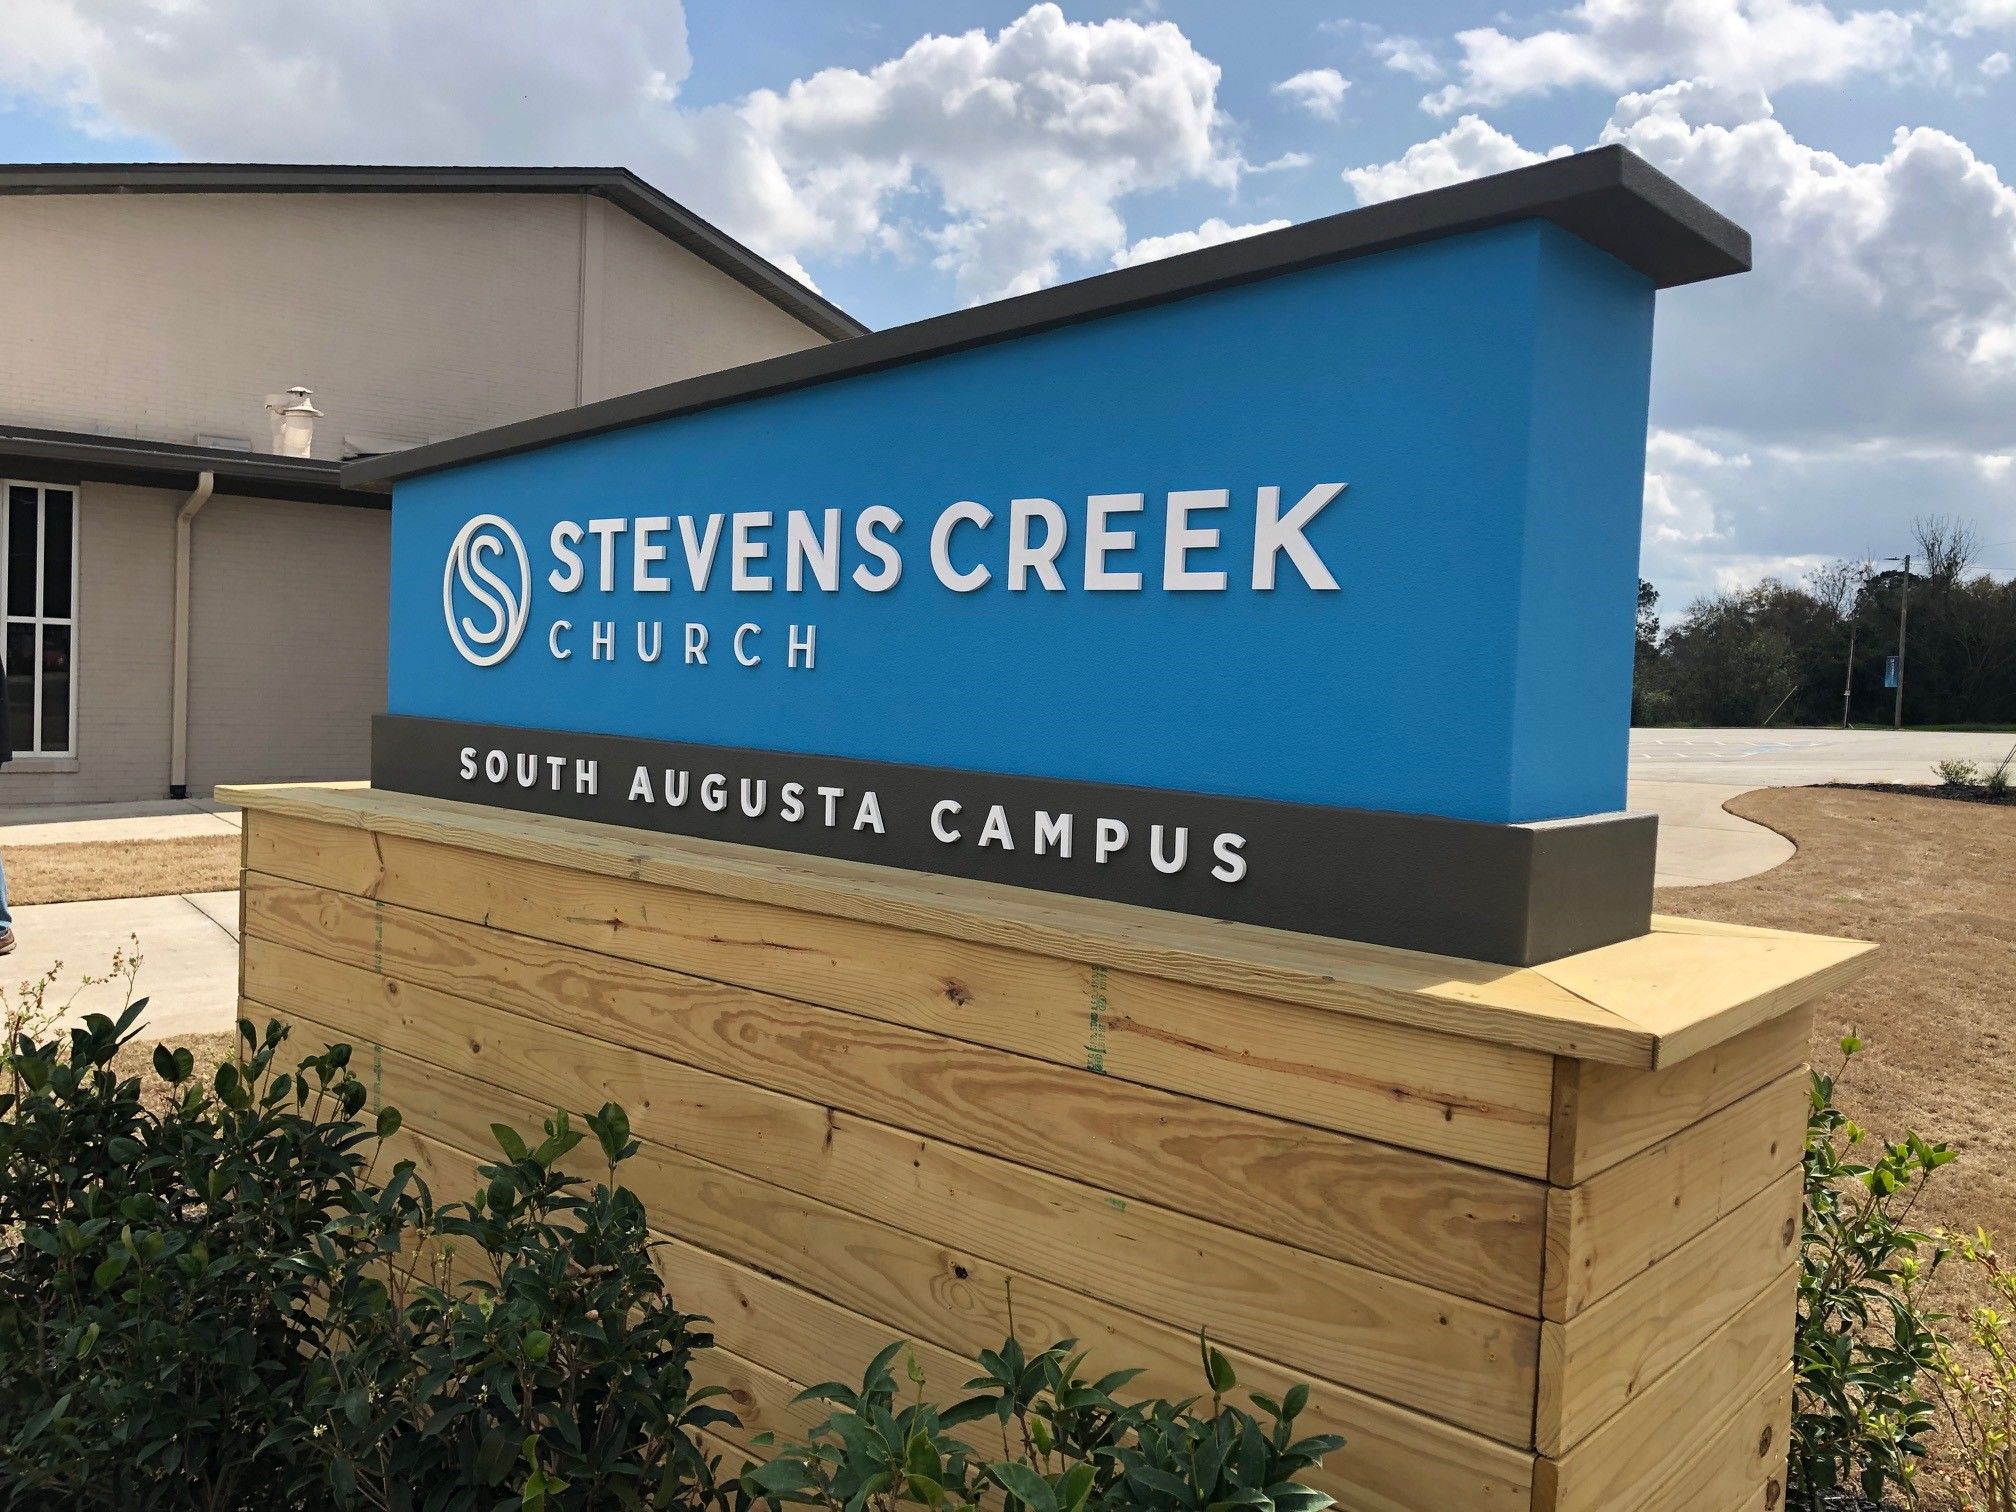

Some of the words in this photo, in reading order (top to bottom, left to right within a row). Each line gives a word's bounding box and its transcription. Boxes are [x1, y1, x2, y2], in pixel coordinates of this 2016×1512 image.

[548, 504, 903, 593] STEVENS
[930, 482, 1347, 592] CREEK
[549, 620, 817, 669] CHURCH
[459, 747, 599, 796] SOUTH
[628, 765, 887, 835] AUGUSTA
[930, 798, 1248, 884] CAMPUS
